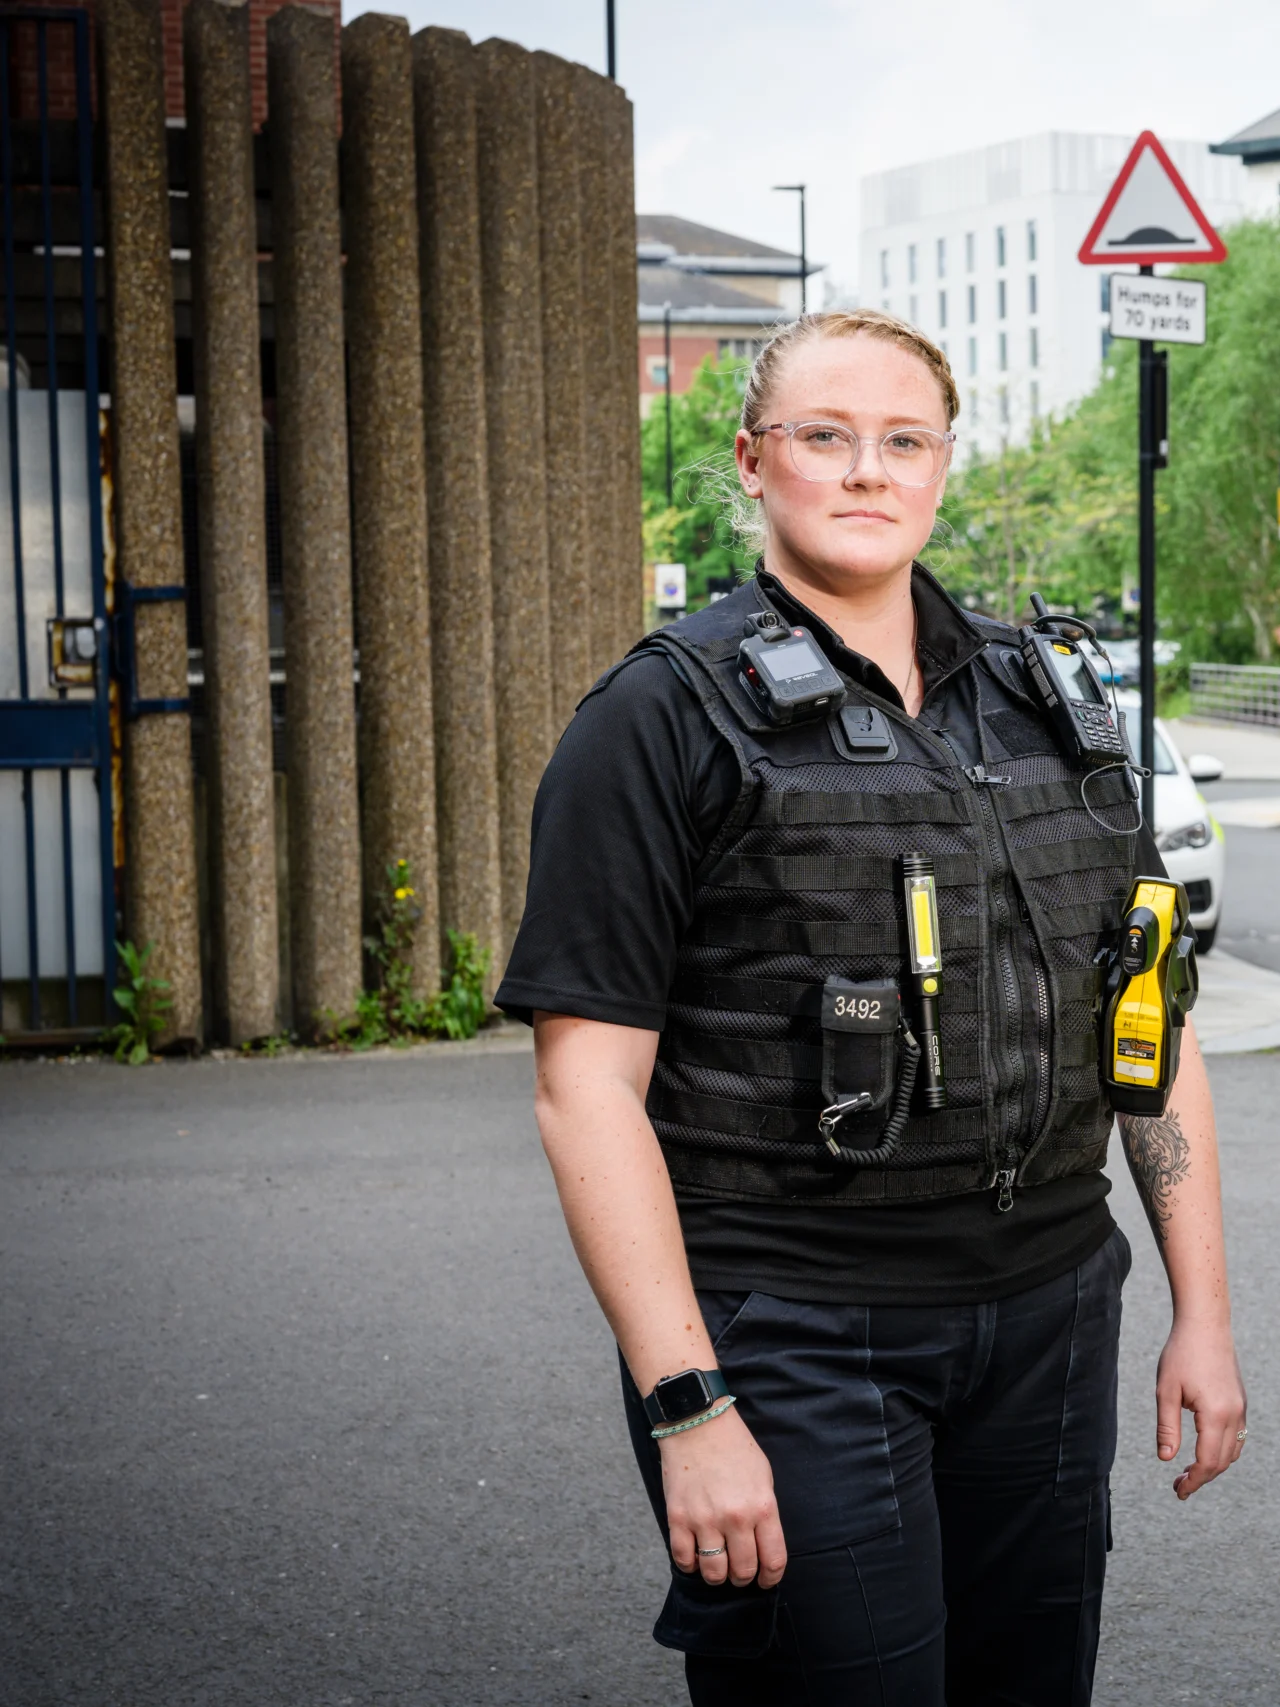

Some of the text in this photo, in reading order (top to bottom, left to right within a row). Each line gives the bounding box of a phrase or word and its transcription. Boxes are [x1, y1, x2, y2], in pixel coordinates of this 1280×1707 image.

[1118, 286, 1197, 308] Humps for
[1124, 308, 1191, 332] 70 yards
[834, 996, 881, 1019] 3492
[932, 1035, 941, 1076] CORE
